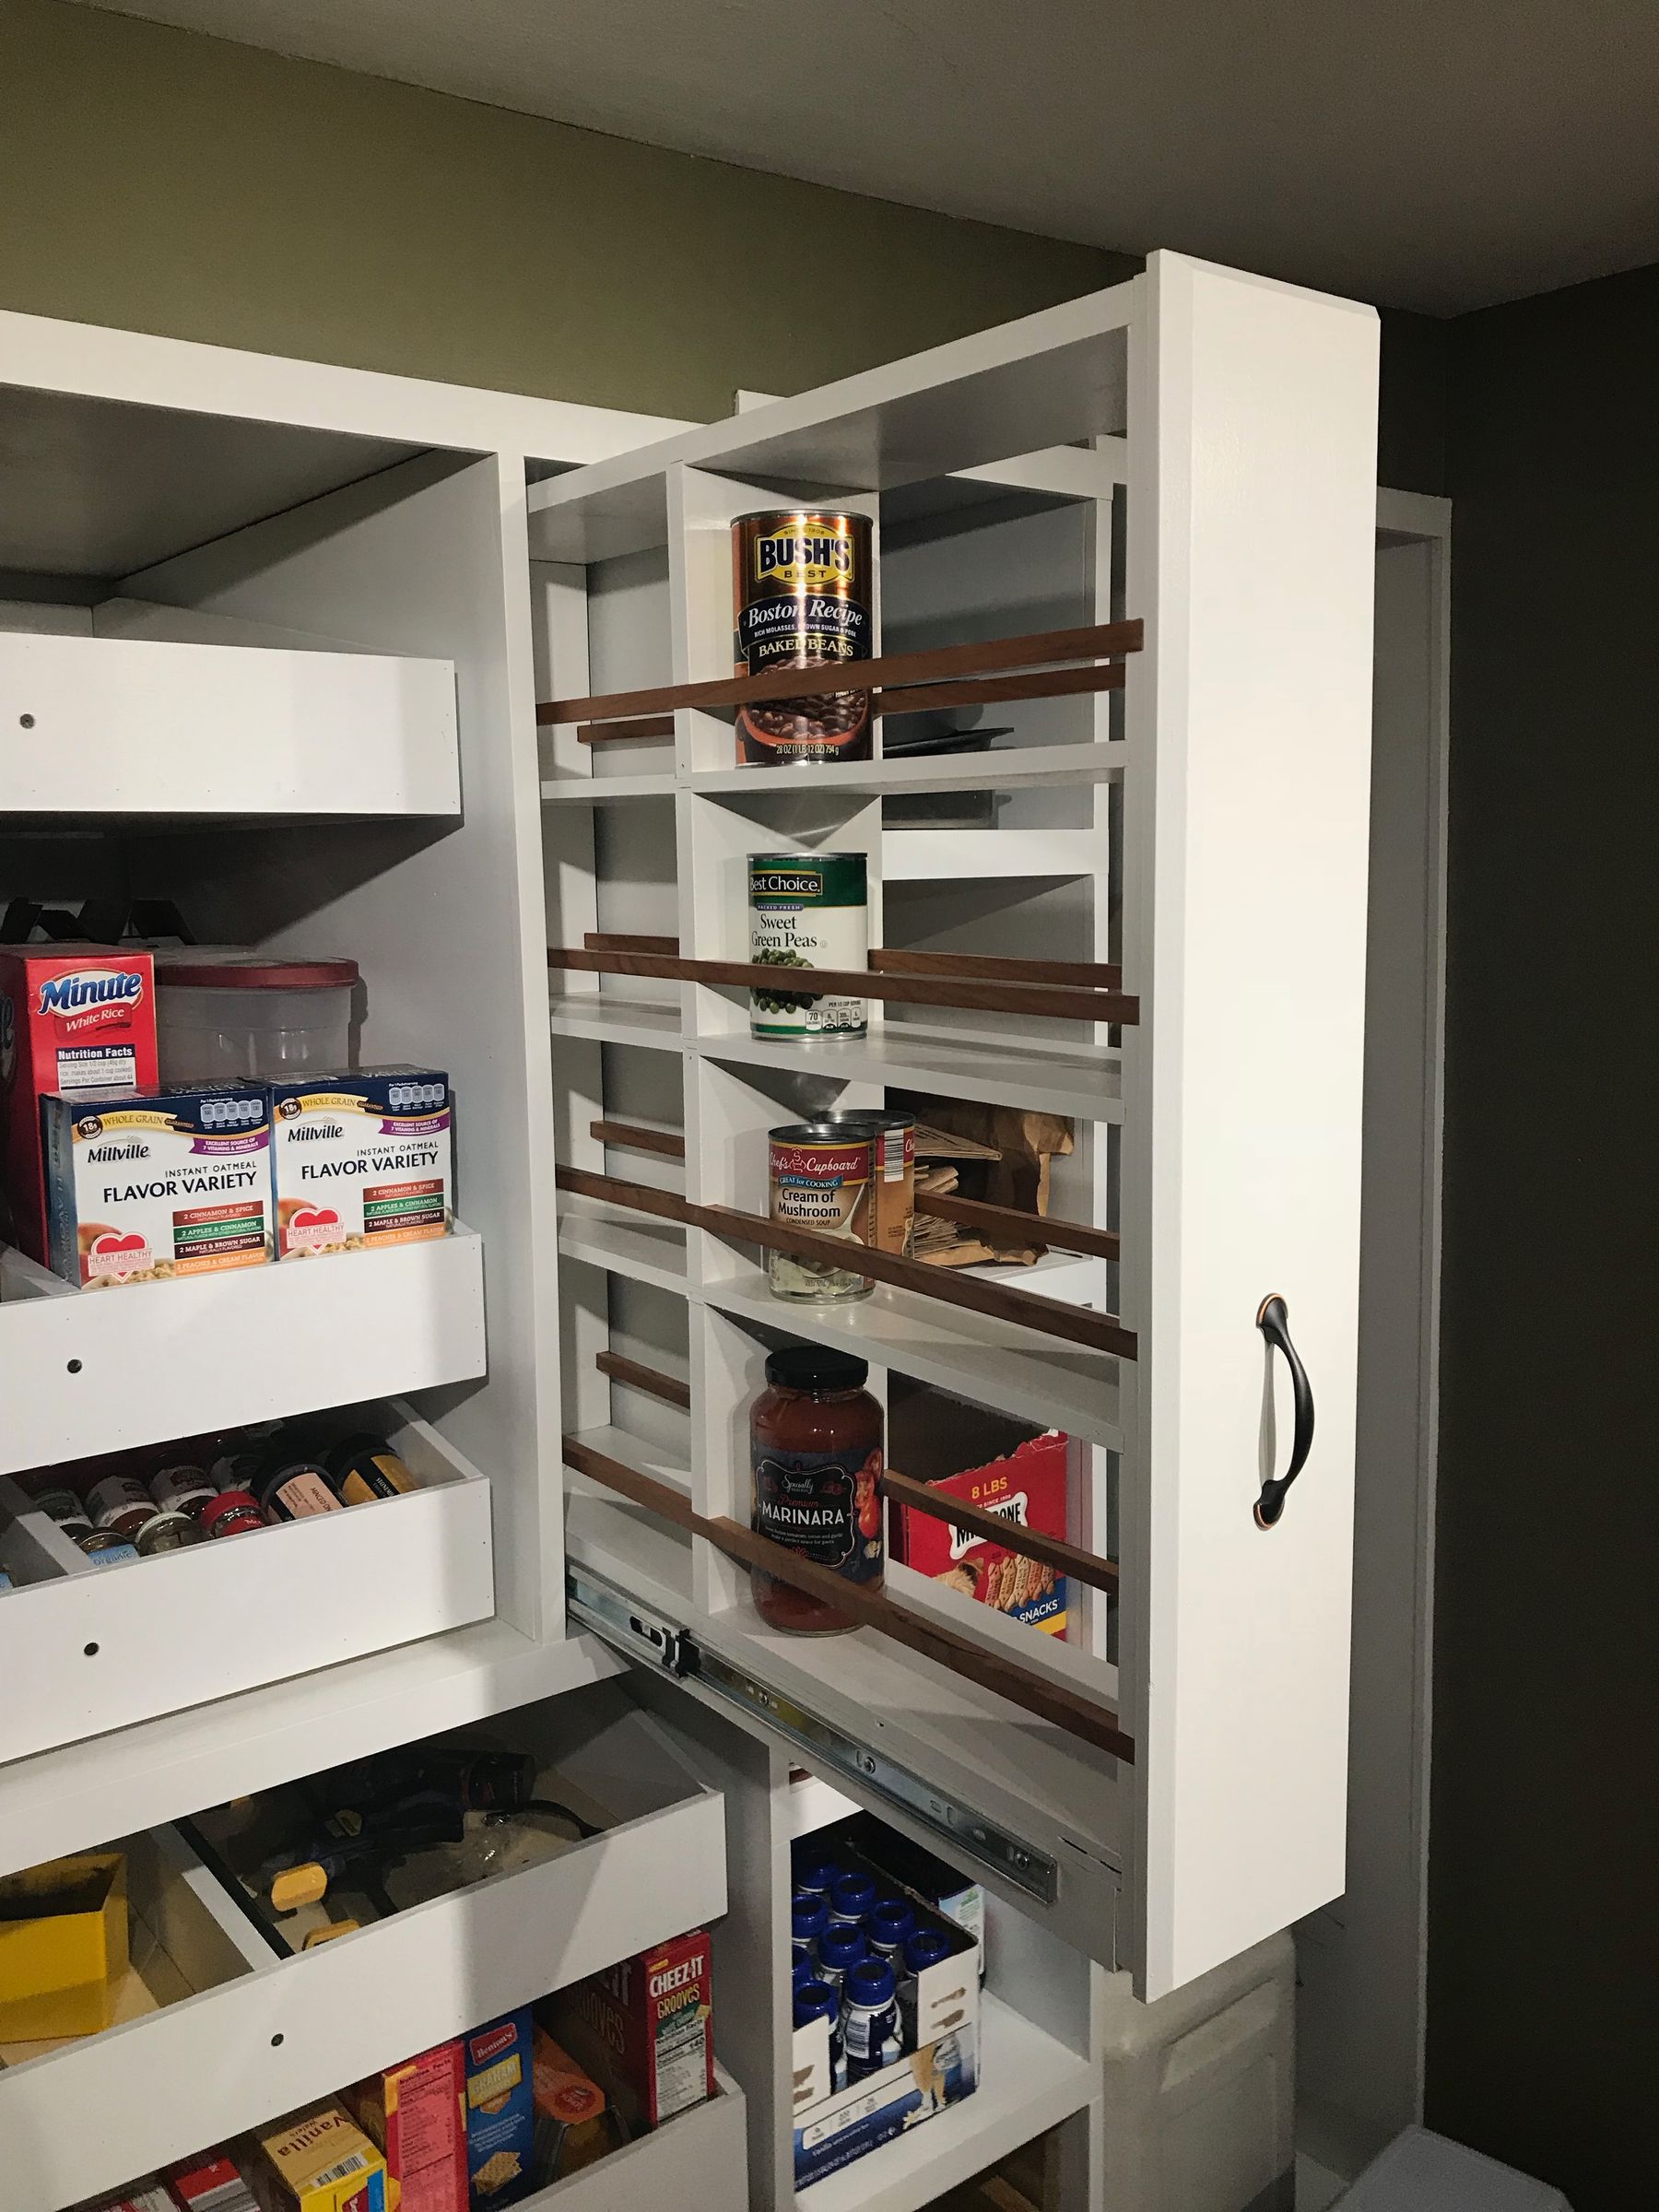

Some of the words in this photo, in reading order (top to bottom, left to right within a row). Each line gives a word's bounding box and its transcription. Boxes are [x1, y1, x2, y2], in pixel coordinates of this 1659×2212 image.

[760, 538, 850, 572] BUSH'S
[784, 570, 826, 578] BEST
[748, 603, 805, 628] Boston
[809, 599, 863, 627] Recipe
[759, 639, 804, 657] BAKED
[808, 639, 853, 656] BEANS
[776, 746, 782, 754] 28
[783, 745, 792, 754] OZ
[798, 745, 806, 754] LB
[807, 745, 814, 754] 12
[815, 745, 825, 754] OZ)
[826, 745, 835, 754] 794
[835, 747, 839, 756] g
[768, 876, 818, 892] Choice
[760, 913, 796, 929] Sweet
[751, 931, 782, 947] Green
[784, 933, 818, 947] Peas
[38, 972, 142, 1015] Minute
[66, 1015, 100, 1032] White
[101, 1008, 124, 1020] Rice
[809, 1012, 818, 1020] 70
[58, 1049, 102, 1061] Nutrition
[105, 1047, 133, 1058] Facts
[302, 1097, 330, 1107] WHOLE
[332, 1097, 357, 1106] GRAIN
[103, 1115, 134, 1125] WHOLE
[135, 1114, 164, 1124] GRAIN
[288, 1124, 343, 1142] Millville
[87, 1145, 149, 1163] Millville
[358, 1146, 394, 1157] INSTANT
[399, 1141, 439, 1152] OATMEAL
[165, 1166, 208, 1178] INSTANT
[212, 1161, 257, 1172] OATMEAL
[301, 1159, 368, 1180] FLAVOR
[371, 1151, 439, 1171] VARIETY
[806, 1158, 858, 1175] Cupboard
[103, 1180, 179, 1203] FLAVOR
[182, 1171, 257, 1193] VARIETY
[378, 1185, 412, 1194] CINNAMON
[782, 1188, 818, 1203] Cream
[821, 1189, 837, 1202] of
[376, 1202, 398, 1211] APPLES
[405, 1197, 438, 1206] CINNAMON
[778, 1202, 841, 1217] Mushroom
[189, 1209, 228, 1218] CINNAMON
[219, 1220, 257, 1231] CINNAMON
[785, 1218, 815, 1226] CONDENSED
[288, 1228, 312, 1237] HEART
[312, 1224, 345, 1233] HEALTHY
[184, 1244, 207, 1253] MAPLE
[215, 1240, 238, 1248] BROWN
[240, 1236, 260, 1244] SUGAR
[89, 1253, 115, 1265] HEART
[117, 1251, 152, 1261] HEALTHY
[971, 1486, 980, 1499] 8
[982, 1477, 1008, 1495] LBS
[983, 1498, 999, 1508] SINCE
[1000, 1493, 1012, 1501] 1908
[762, 1500, 844, 1525] MARINARA
[92, 1550, 133, 1565] organic
[1019, 1599, 1058, 1622] SNACKS
[649, 1955, 704, 1998] CHEEZ-IT
[656, 1983, 700, 2019] GROOVES
[277, 2116, 352, 2157] Vanilla
